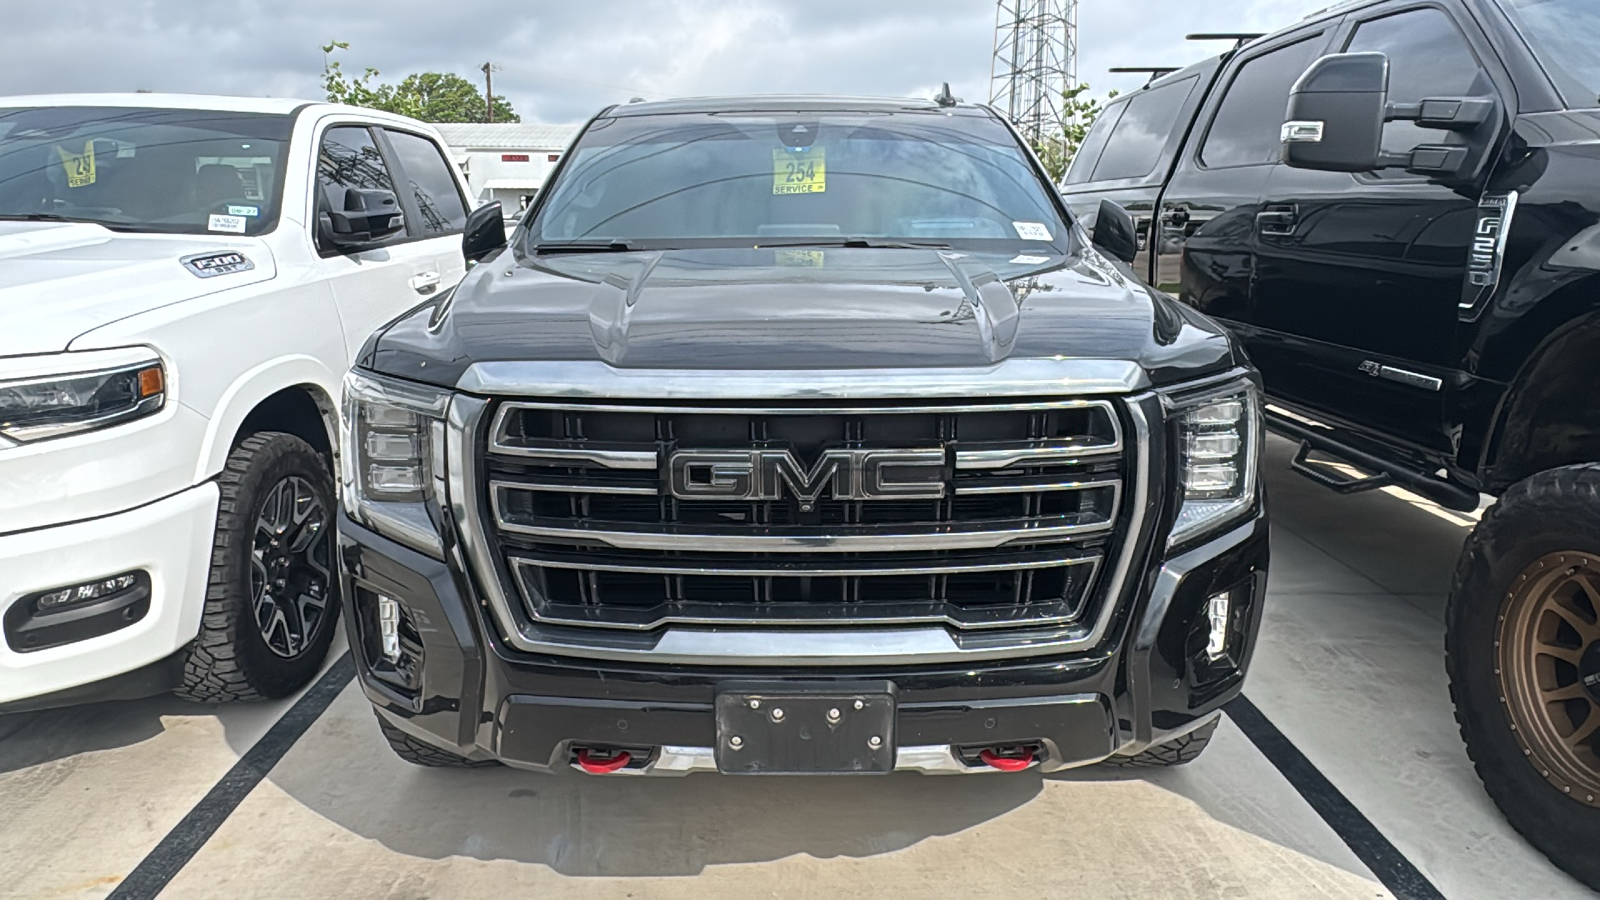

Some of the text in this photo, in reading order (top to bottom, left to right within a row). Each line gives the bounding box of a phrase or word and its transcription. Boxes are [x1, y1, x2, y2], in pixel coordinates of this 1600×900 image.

[786, 160, 815, 183] 254
[774, 184, 813, 194] SERVICE
[193, 254, 242, 269] 1500
[670, 449, 945, 500] GMC
